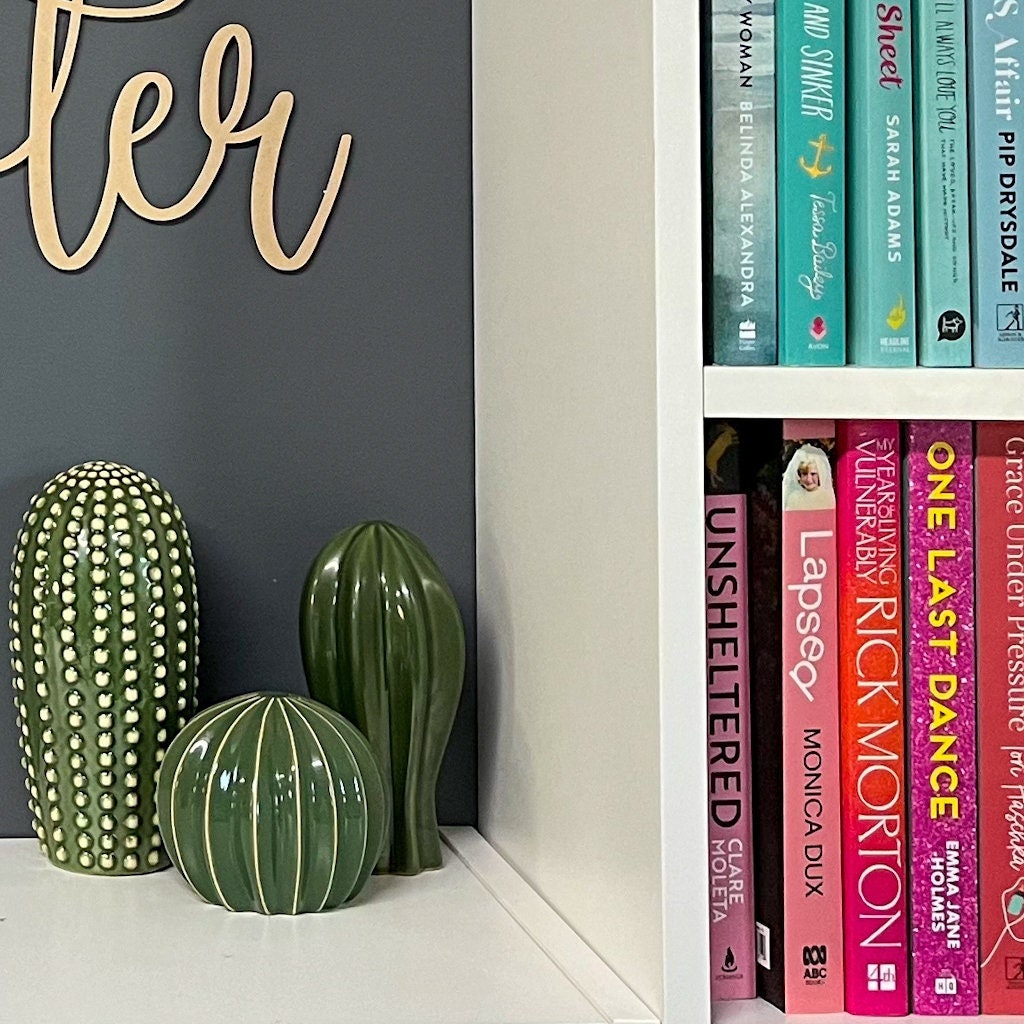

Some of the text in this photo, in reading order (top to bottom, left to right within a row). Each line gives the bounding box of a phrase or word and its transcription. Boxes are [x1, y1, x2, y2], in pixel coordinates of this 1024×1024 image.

[739, 11, 753, 88] WOMAN
[802, 2, 831, 40] AND
[876, 4, 903, 90] Sheet
[935, 20, 956, 66] ALWAYS
[799, 43, 834, 122] SINKER
[936, 71, 956, 102] LOVE
[985, 13, 1022, 121] Affair
[936, 105, 957, 134] YOU
[739, 101, 755, 307] BELINDA ALEXANDRA
[886, 114, 902, 263] SARAH ADAMS
[998, 131, 1019, 293] PIP DRYSDALE
[798, 191, 837, 300] Tessa Bailey
[876, 438, 895, 451] MY
[876, 450, 896, 505] YEAR
[855, 439, 877, 585] VULNERABLY
[878, 519, 898, 585] LIVING
[787, 530, 833, 702] Lapsed
[1005, 437, 1024, 732] Grace Under Pressure
[705, 507, 742, 828] UNSHELTERED
[926, 441, 961, 820] ONE LAST DANCE
[803, 729, 824, 897] MONICA DUX
[855, 596, 902, 948] RICK MORTON
[711, 839, 727, 923] MOLETA
[727, 838, 744, 904] CLARE
[931, 857, 946, 933] HOLMES
[946, 840, 961, 949] EMMA JANE
[804, 968, 827, 978] ABC
